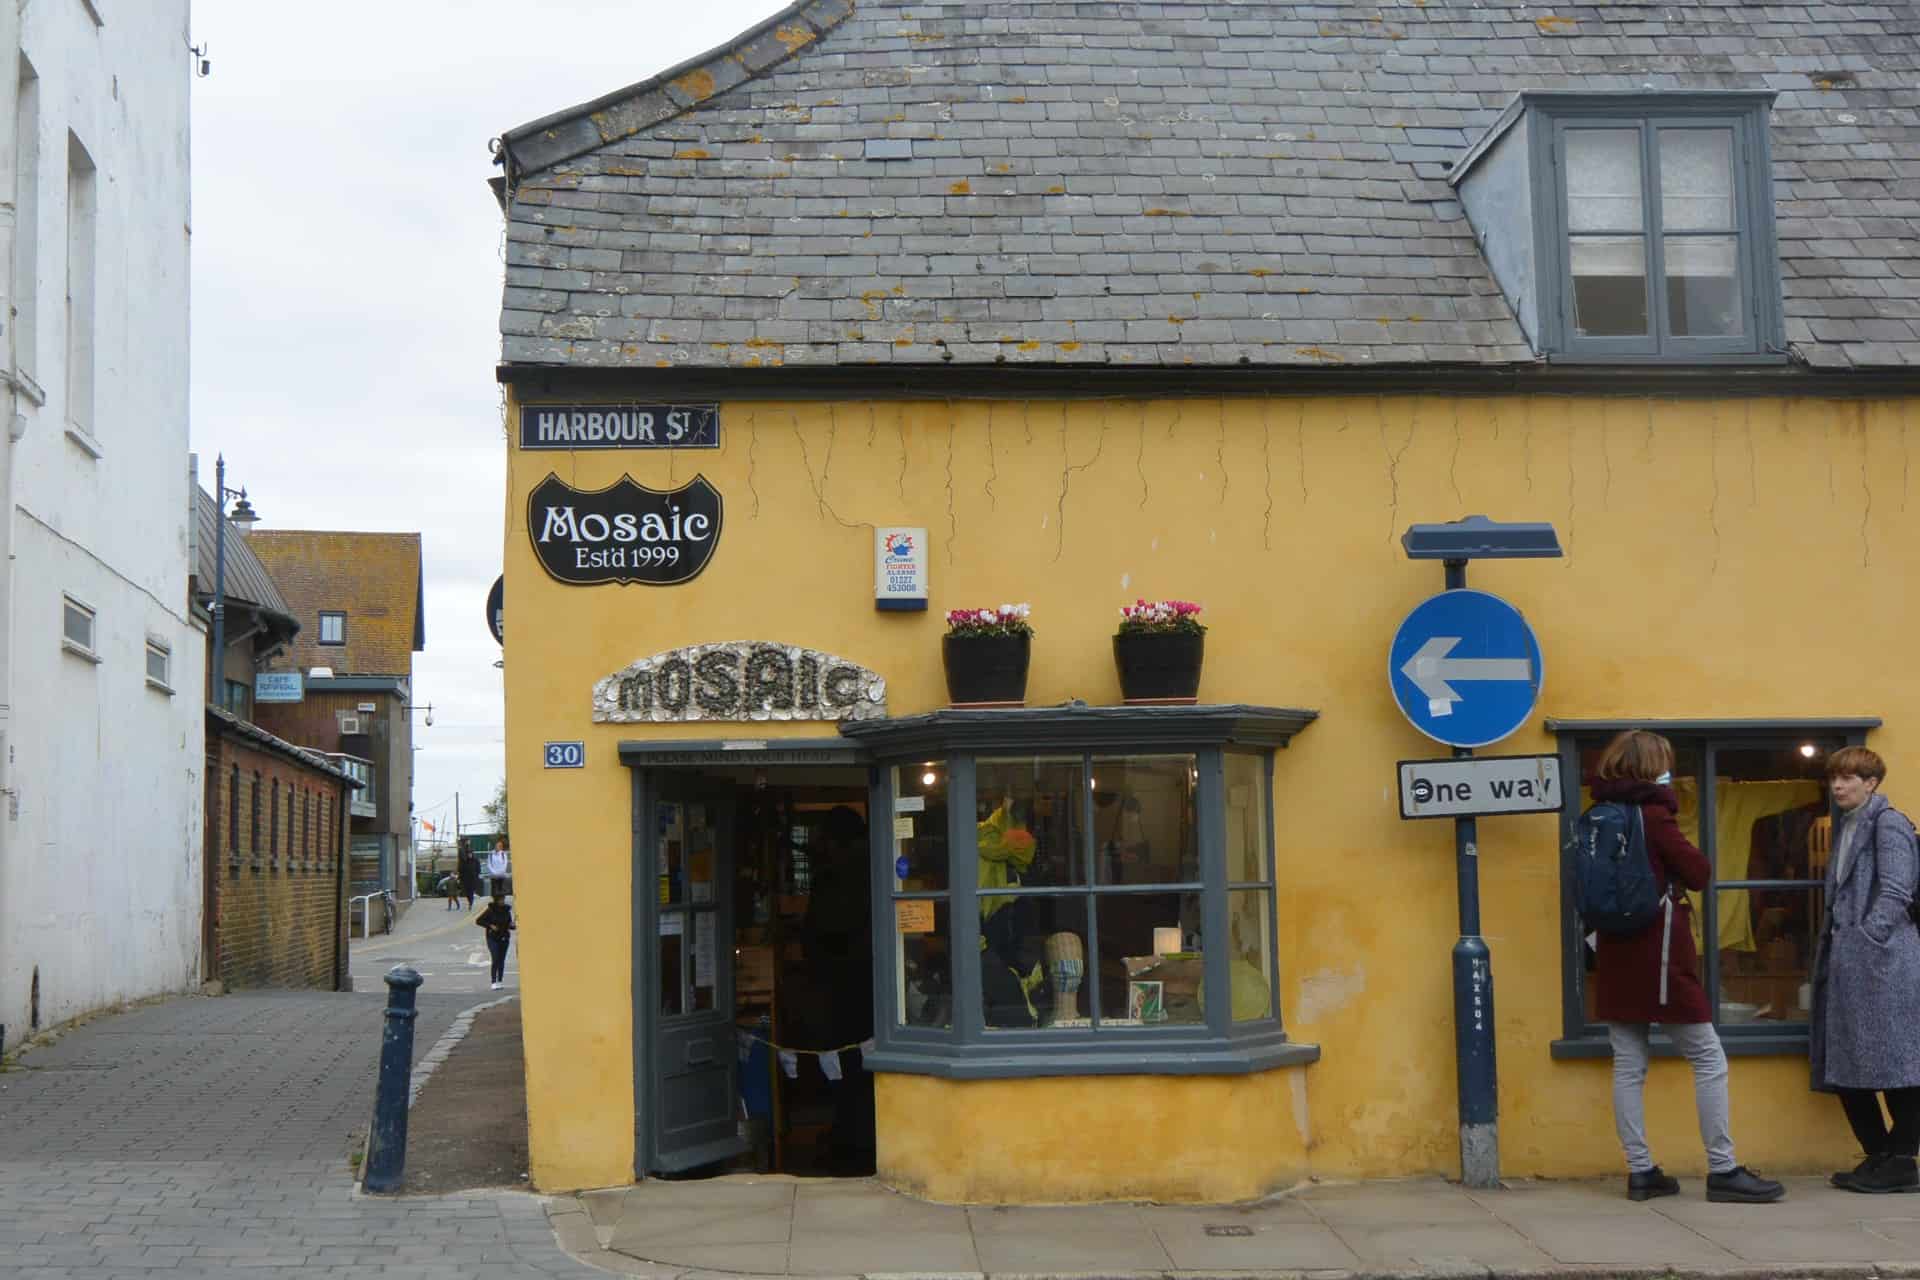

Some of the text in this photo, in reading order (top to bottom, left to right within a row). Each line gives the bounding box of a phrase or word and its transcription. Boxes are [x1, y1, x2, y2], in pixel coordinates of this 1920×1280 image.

[538, 412, 655, 441] HARBOUR
[538, 505, 711, 542] Mosaic
[575, 546, 680, 568] Est'd 1999
[549, 745, 579, 764] 30
[1411, 778, 1551, 803] One way
